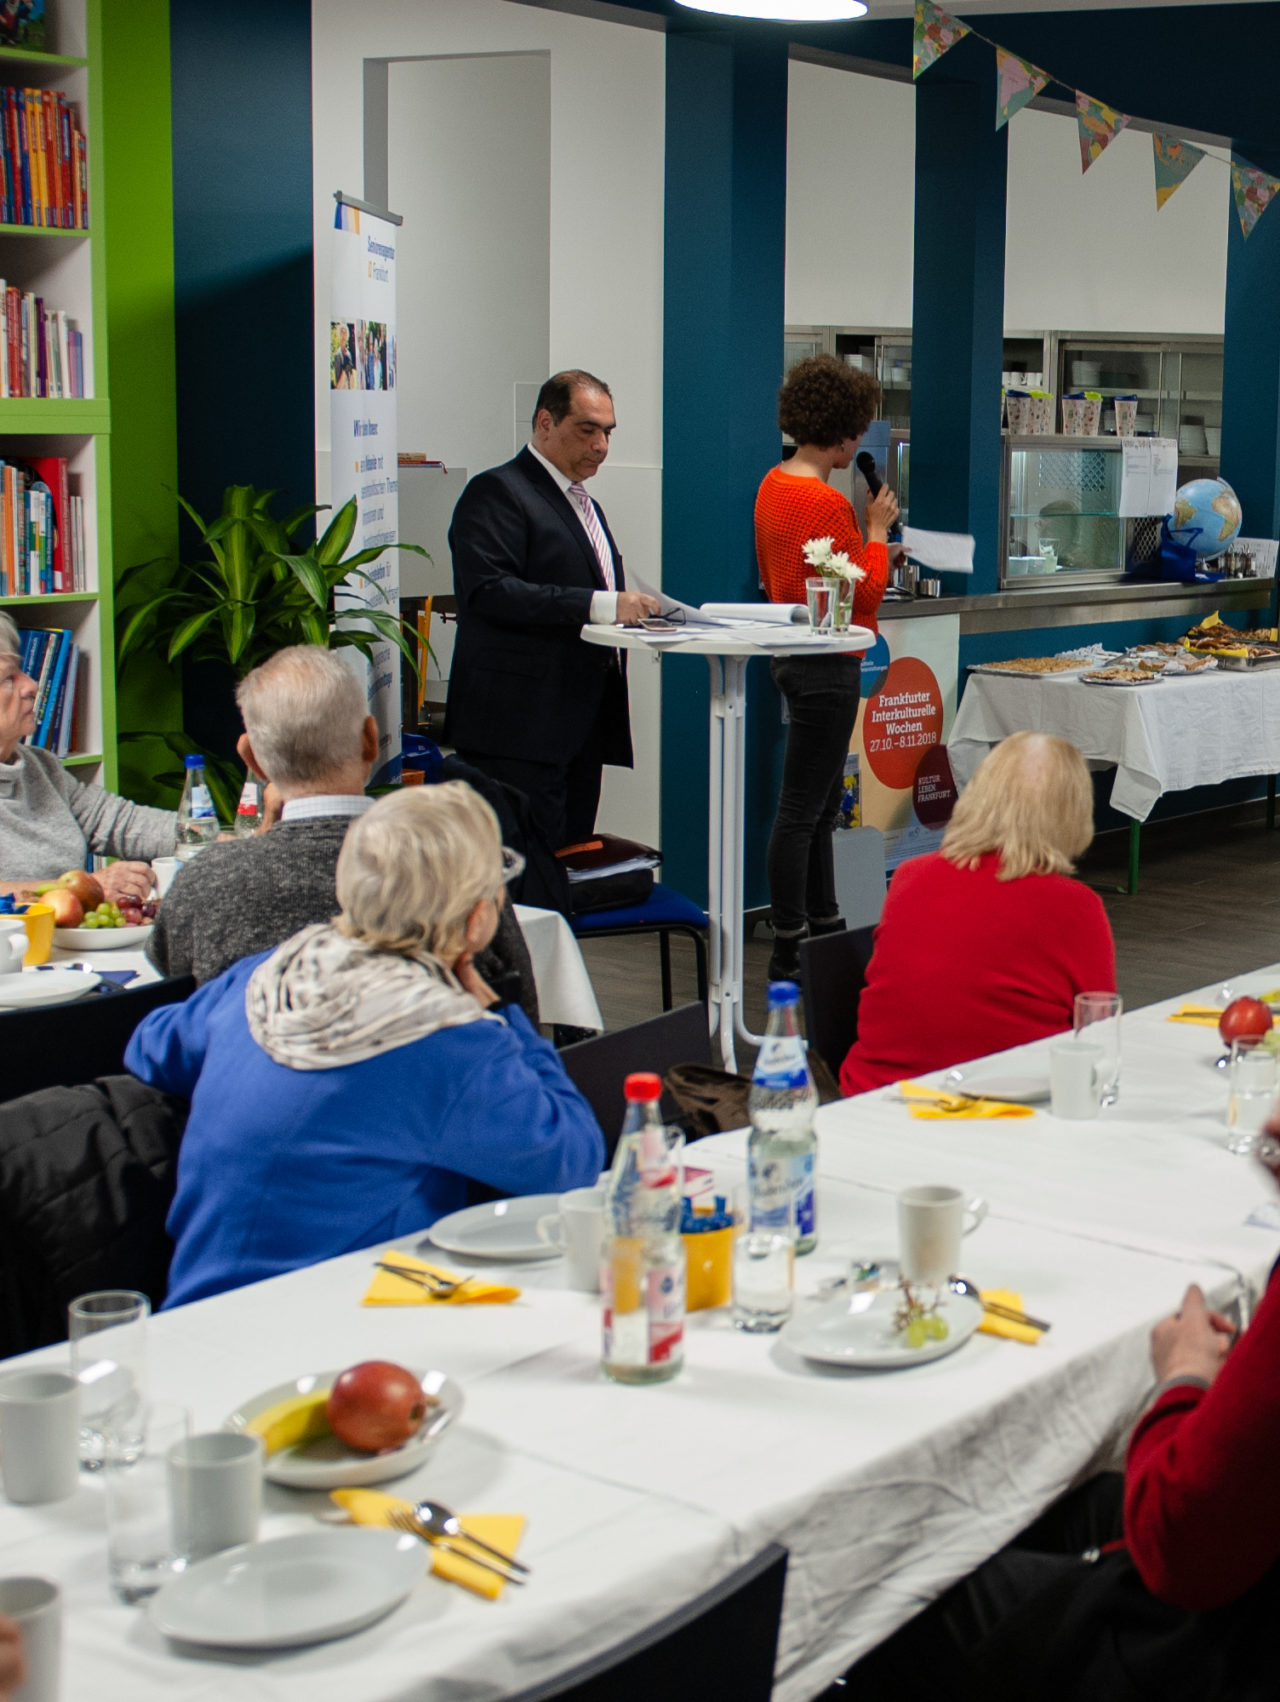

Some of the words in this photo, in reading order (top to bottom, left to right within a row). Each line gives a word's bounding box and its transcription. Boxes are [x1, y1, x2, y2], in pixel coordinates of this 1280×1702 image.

[879, 692, 930, 707] Frankfurter
[872, 704, 936, 722] Interkulturelle
[886, 721, 922, 735] Wochen
[918, 783, 936, 793] LEBEN
